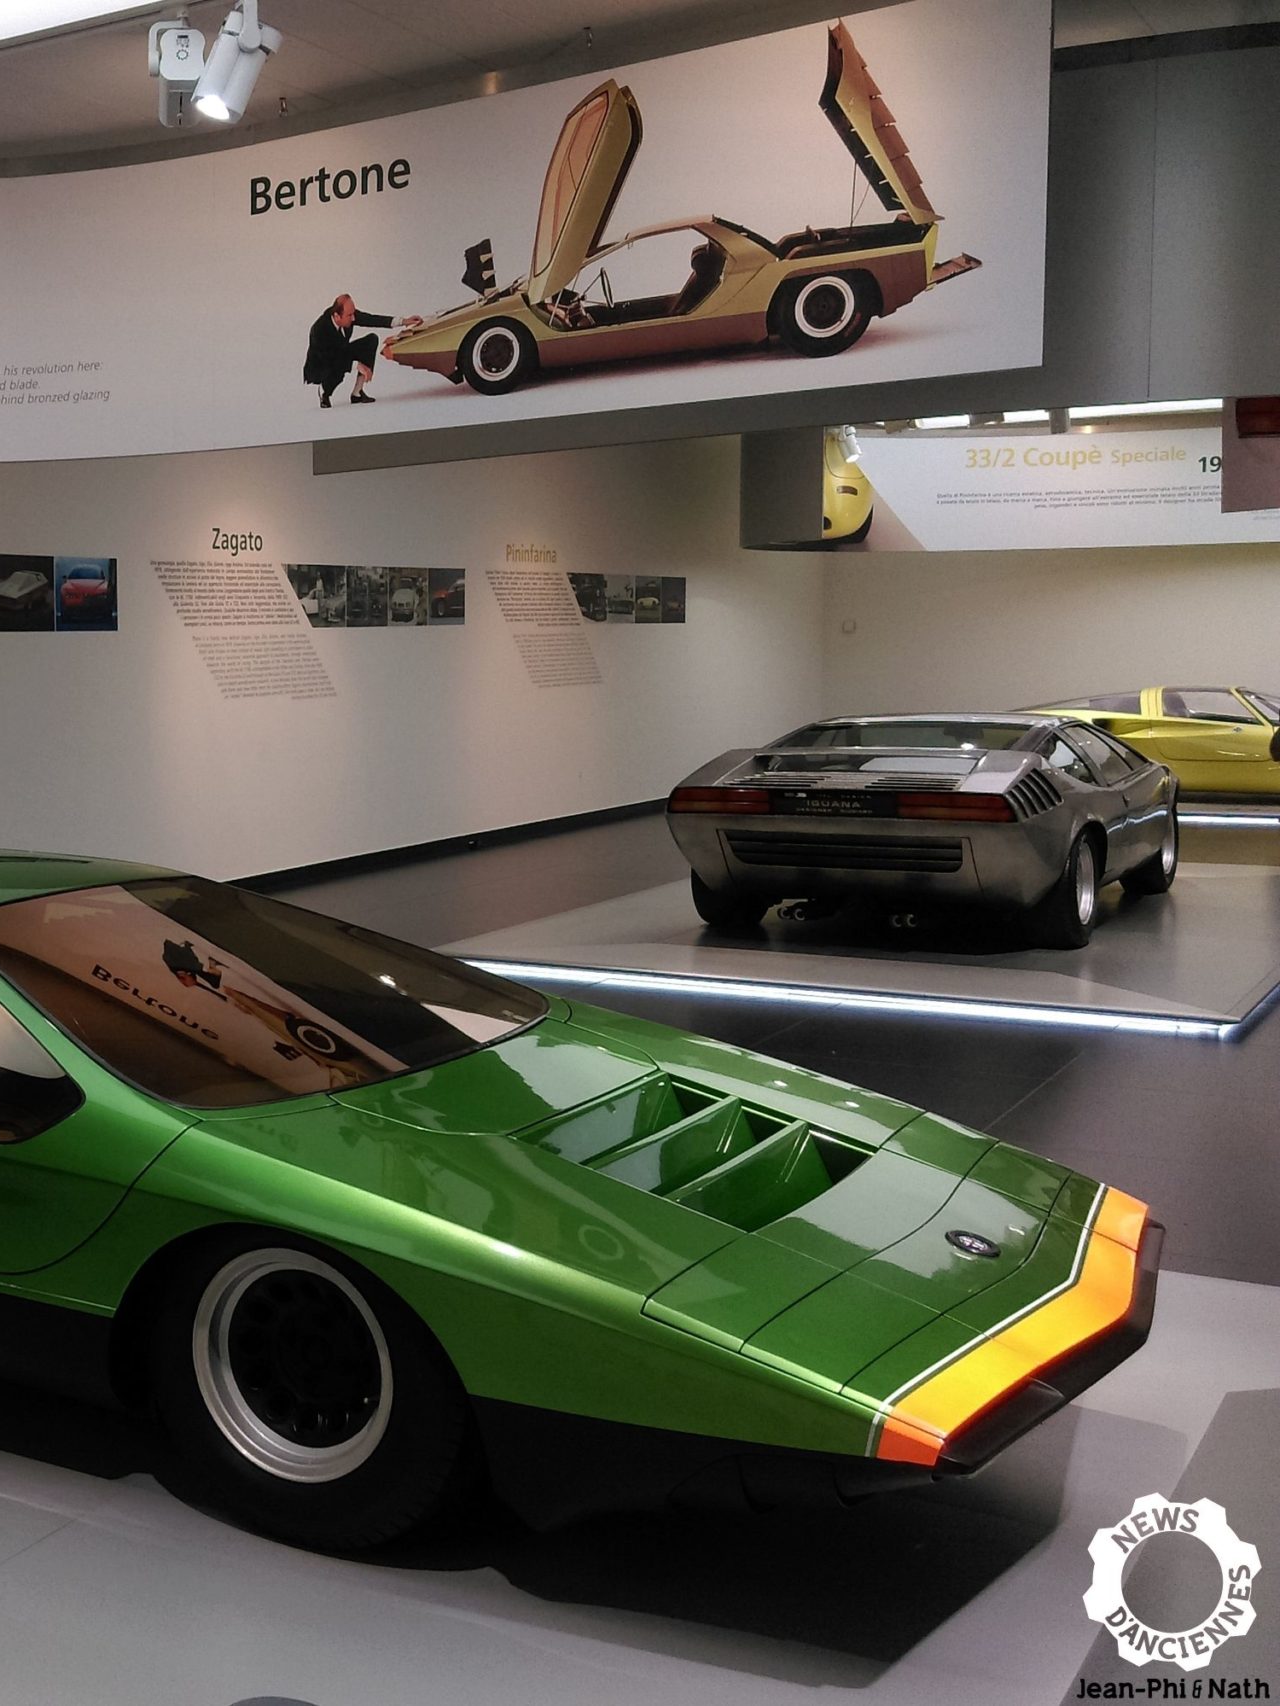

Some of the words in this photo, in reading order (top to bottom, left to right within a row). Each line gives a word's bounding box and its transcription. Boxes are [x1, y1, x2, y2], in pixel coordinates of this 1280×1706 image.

[250, 158, 411, 216] Bertone
[3, 365, 17, 376] his
[21, 362, 73, 375] revolution
[27, 391, 70, 404] bronzed
[72, 390, 110, 405] glazing
[966, 449, 1016, 468] 33/2
[1023, 445, 1102, 470] Coupè
[1111, 447, 1187, 467] Speciale
[212, 528, 263, 556] Zagato
[506, 544, 557, 563] Pininfarina
